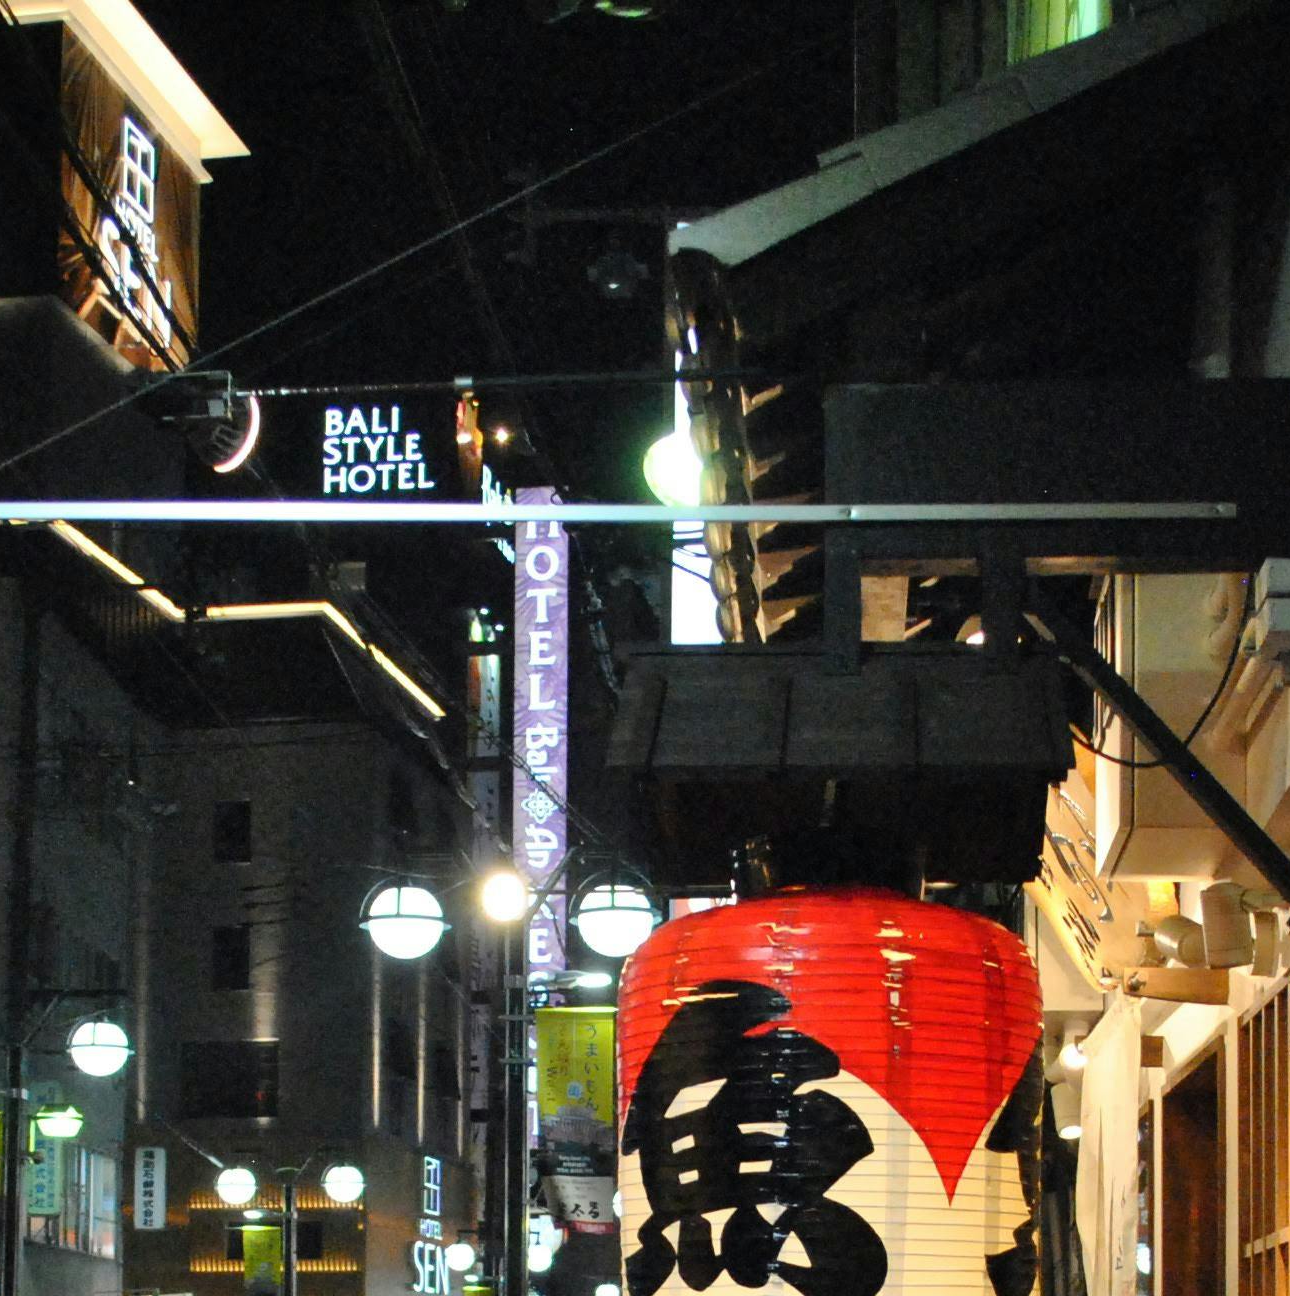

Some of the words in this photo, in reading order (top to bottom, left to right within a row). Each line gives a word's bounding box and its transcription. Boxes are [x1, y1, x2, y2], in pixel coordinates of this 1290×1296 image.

[324, 406, 399, 437] BALI
[322, 433, 423, 465] STYLE
[323, 462, 435, 493] HOTEL
[525, 722, 559, 784] Bali
[419, 1218, 443, 1241] HOTEL
[413, 1240, 450, 1296] SEN
